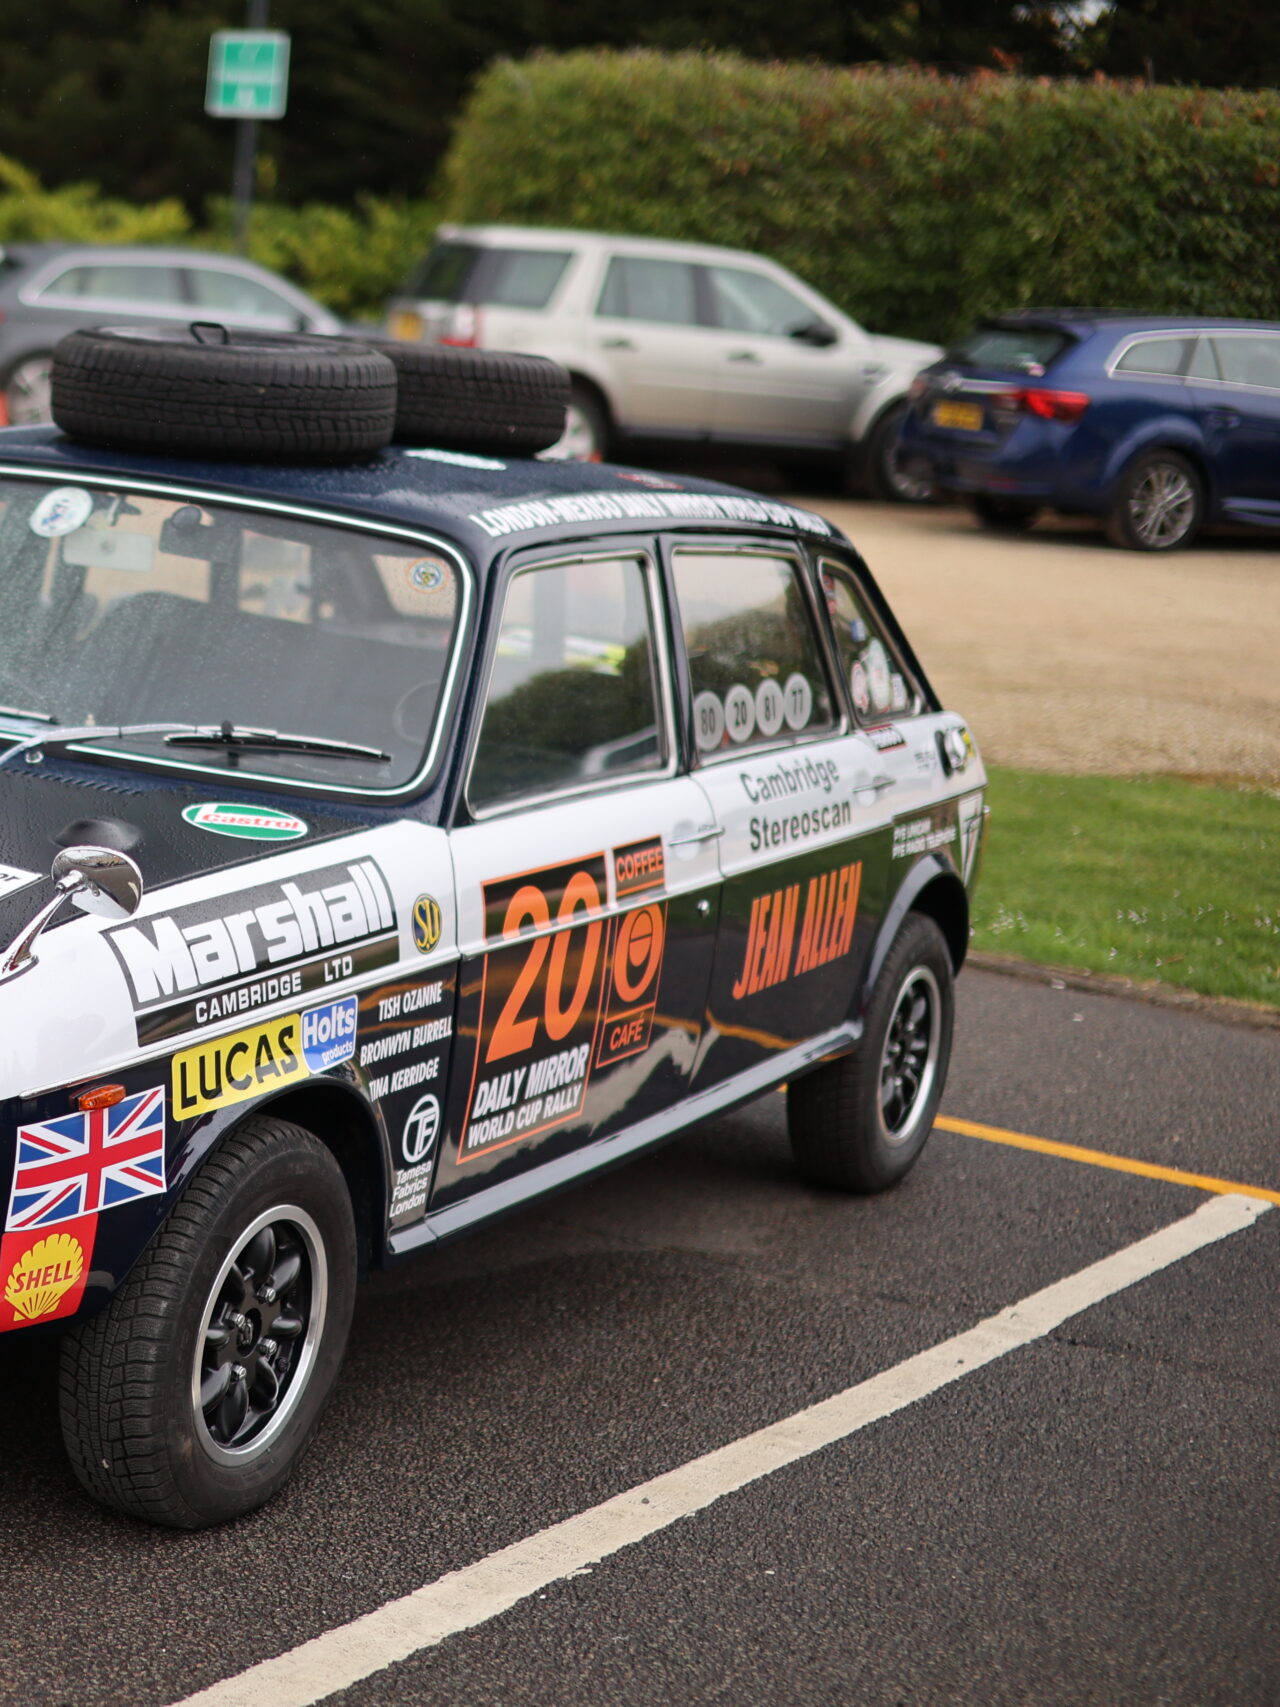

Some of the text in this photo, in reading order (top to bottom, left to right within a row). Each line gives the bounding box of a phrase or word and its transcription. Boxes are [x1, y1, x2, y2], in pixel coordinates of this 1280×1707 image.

[734, 700, 748, 726] 20
[739, 757, 840, 804] Cambridge
[202, 812, 299, 831] Castrol
[750, 800, 851, 852] Stereoscan
[615, 846, 664, 881] COFFEE
[111, 861, 394, 1003] Marshall
[732, 860, 863, 1000] JEAN ALLEN
[195, 956, 353, 1024] CAMBRIDGE LTD
[485, 871, 602, 1064] 20
[378, 981, 443, 1021] TISH OZANNE
[303, 1006, 355, 1049] Holts
[360, 1016, 453, 1067] BRONWYN BURRELL
[179, 1022, 298, 1110] LUCAS
[321, 1041, 353, 1065] products
[369, 1057, 440, 1102] TINA KERRIDGE
[472, 1042, 590, 1119] DAILY MIRROR
[468, 1083, 582, 1148] WORLD CUP RALLY
[392, 1177, 428, 1202] Fabrics
[397, 1161, 432, 1185] Tamesa
[389, 1193, 426, 1218] London
[13, 1260, 73, 1294] SHELL
